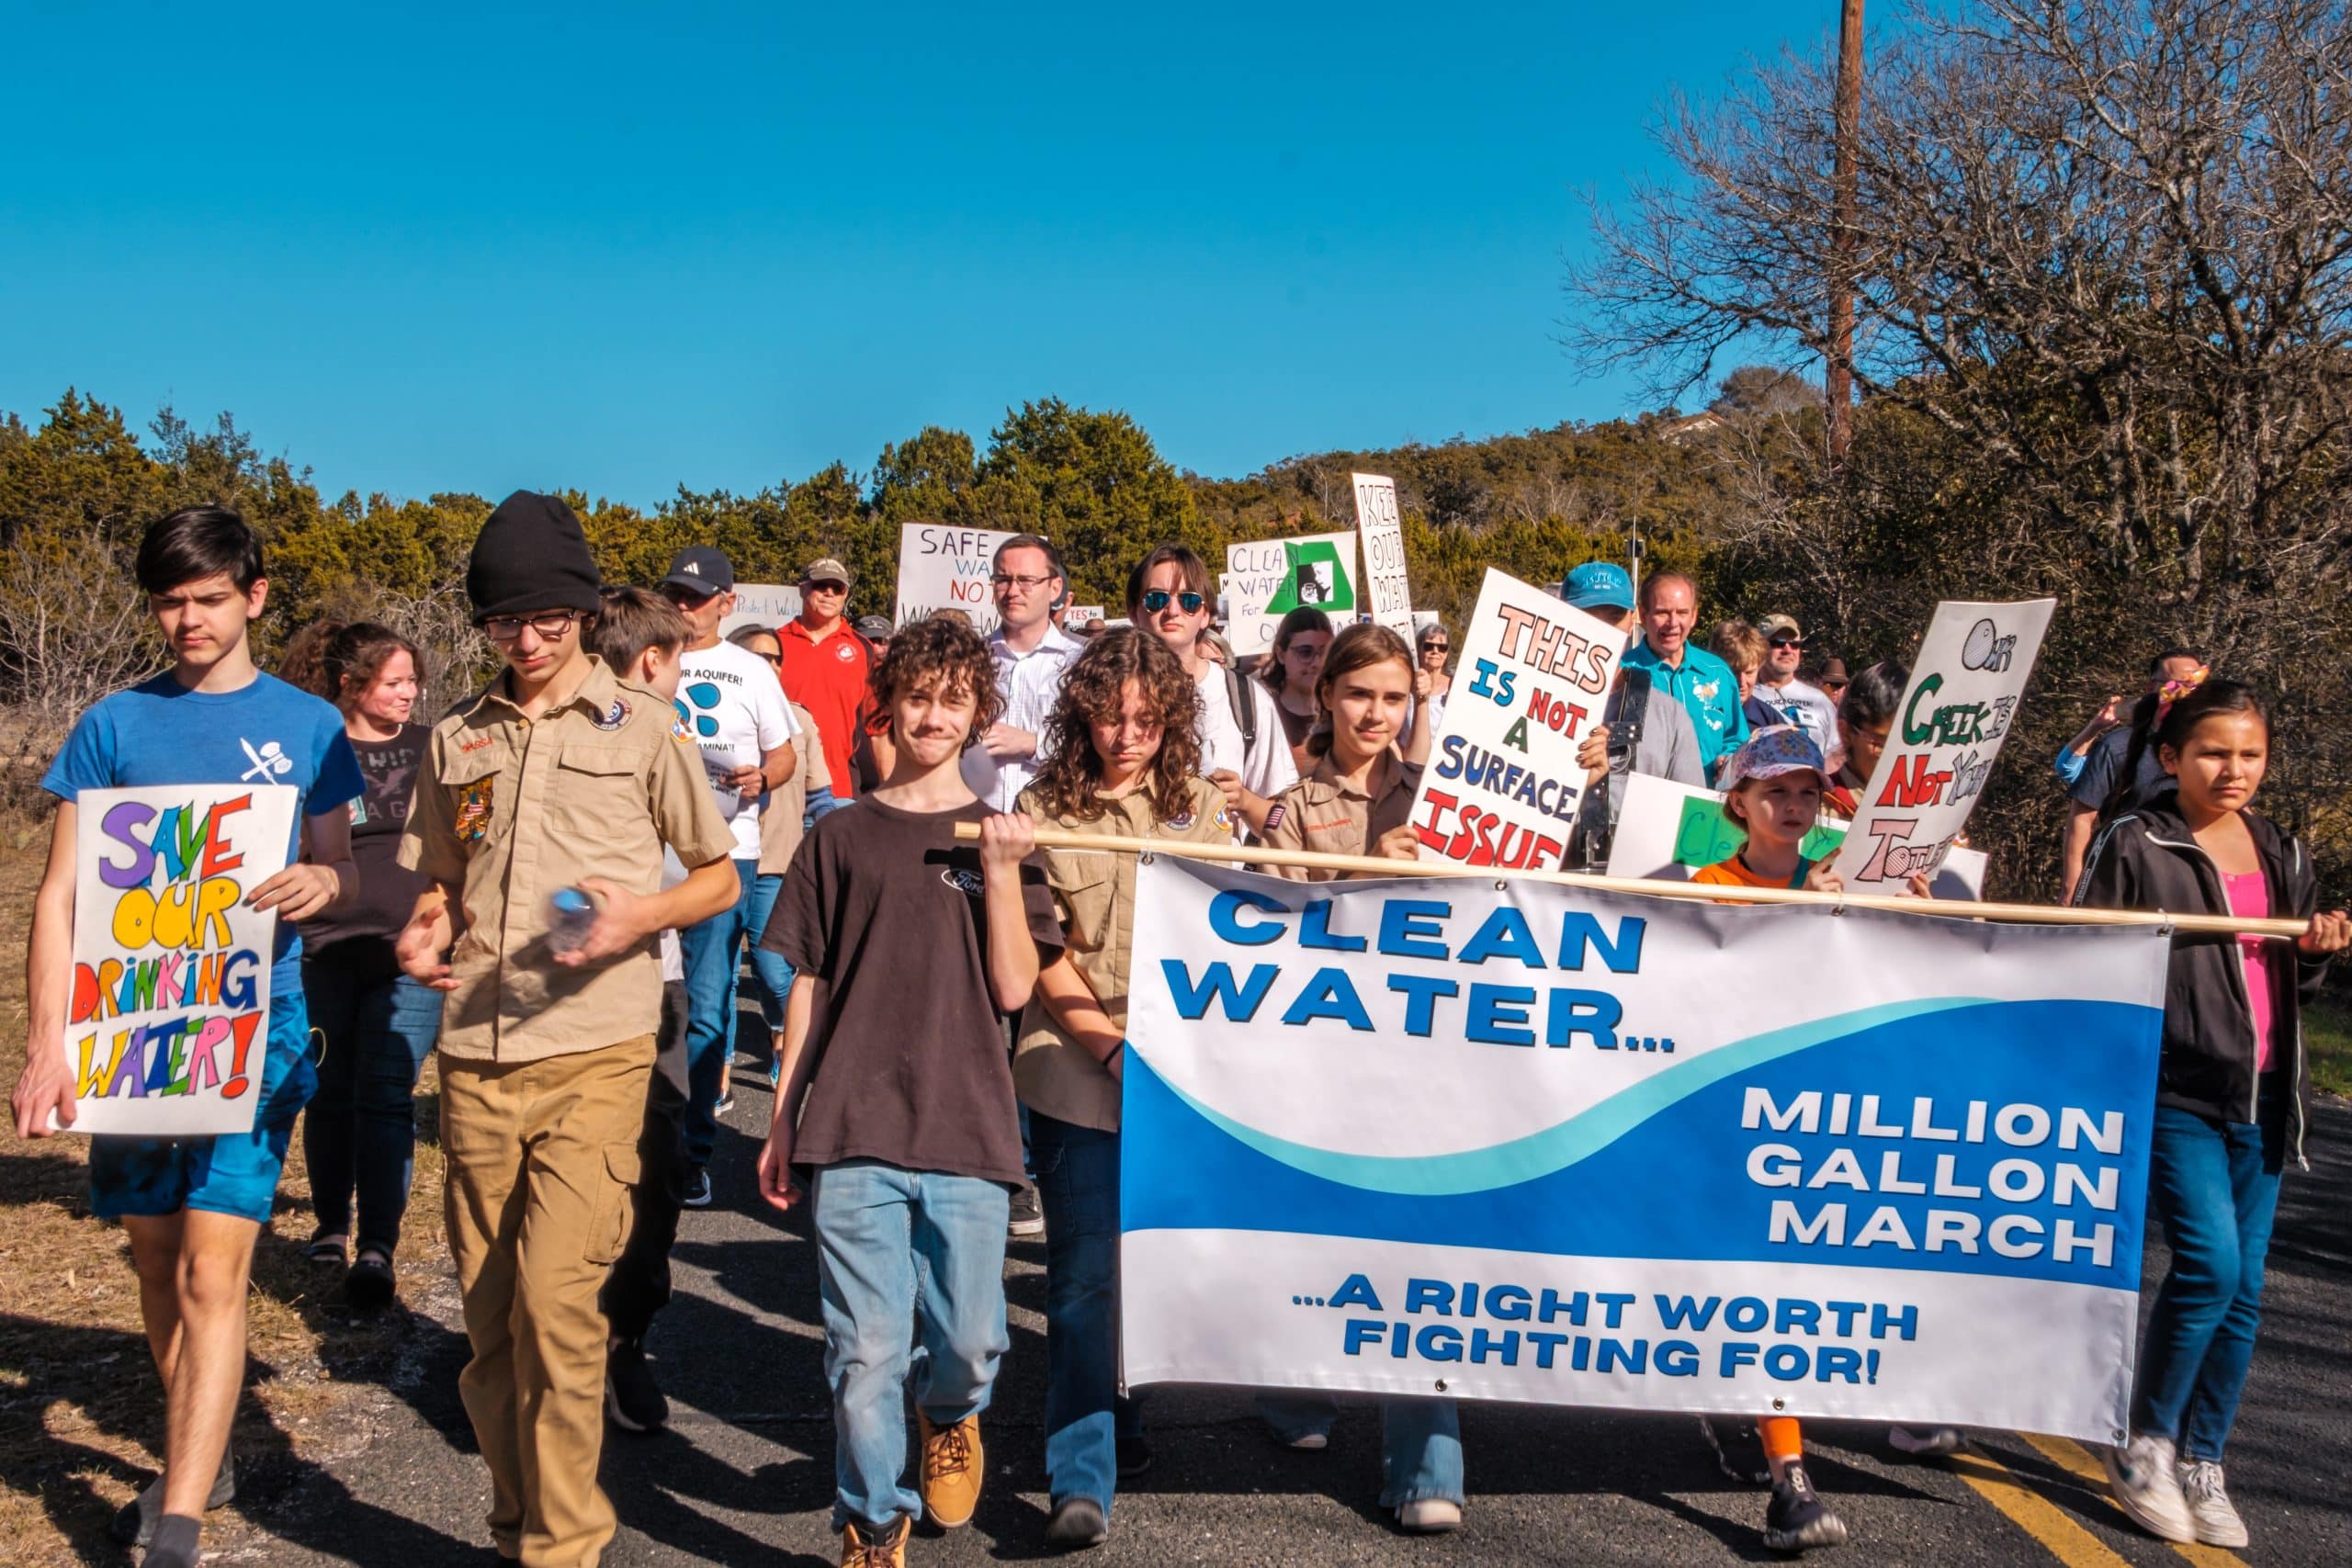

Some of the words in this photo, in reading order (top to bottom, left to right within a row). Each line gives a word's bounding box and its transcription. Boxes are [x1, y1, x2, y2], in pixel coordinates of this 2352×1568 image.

[1360, 484, 1396, 527] KEE
[921, 528, 989, 558] SAFE
[1232, 545, 1300, 573] CLEAN
[1069, 609, 1088, 621] YES
[1089, 610, 1098, 618] to
[1238, 577, 1297, 604] WATER
[1374, 574, 1410, 614] WAT
[680, 669, 691, 678] UR
[695, 669, 742, 686] AQUIFER!
[1497, 602, 1612, 695] THIS
[1468, 657, 1518, 707] IS
[1526, 686, 1589, 740] NOT
[1902, 671, 1992, 748] CREEK
[1502, 715, 1530, 755] A
[1434, 734, 1578, 824] SURFACE
[1874, 753, 1955, 808] NOT
[98, 792, 254, 889] SAVE
[111, 875, 242, 951] OUR
[1207, 888, 1647, 974] CLEAN
[1159, 958, 1676, 1054] WATER...
[75, 1010, 264, 1100] WATER!
[1741, 1086, 2125, 1155] MILLION
[1746, 1143, 2120, 1212] GALLON
[1768, 1200, 2115, 1268] MARCH
[1291, 1272, 1385, 1312] ...A
[1405, 1278, 1636, 1329] RIGHT
[1653, 1293, 1919, 1341] WORTH
[1342, 1318, 1701, 1377] FIGHTING
[1719, 1341, 1882, 1385] FOR!
